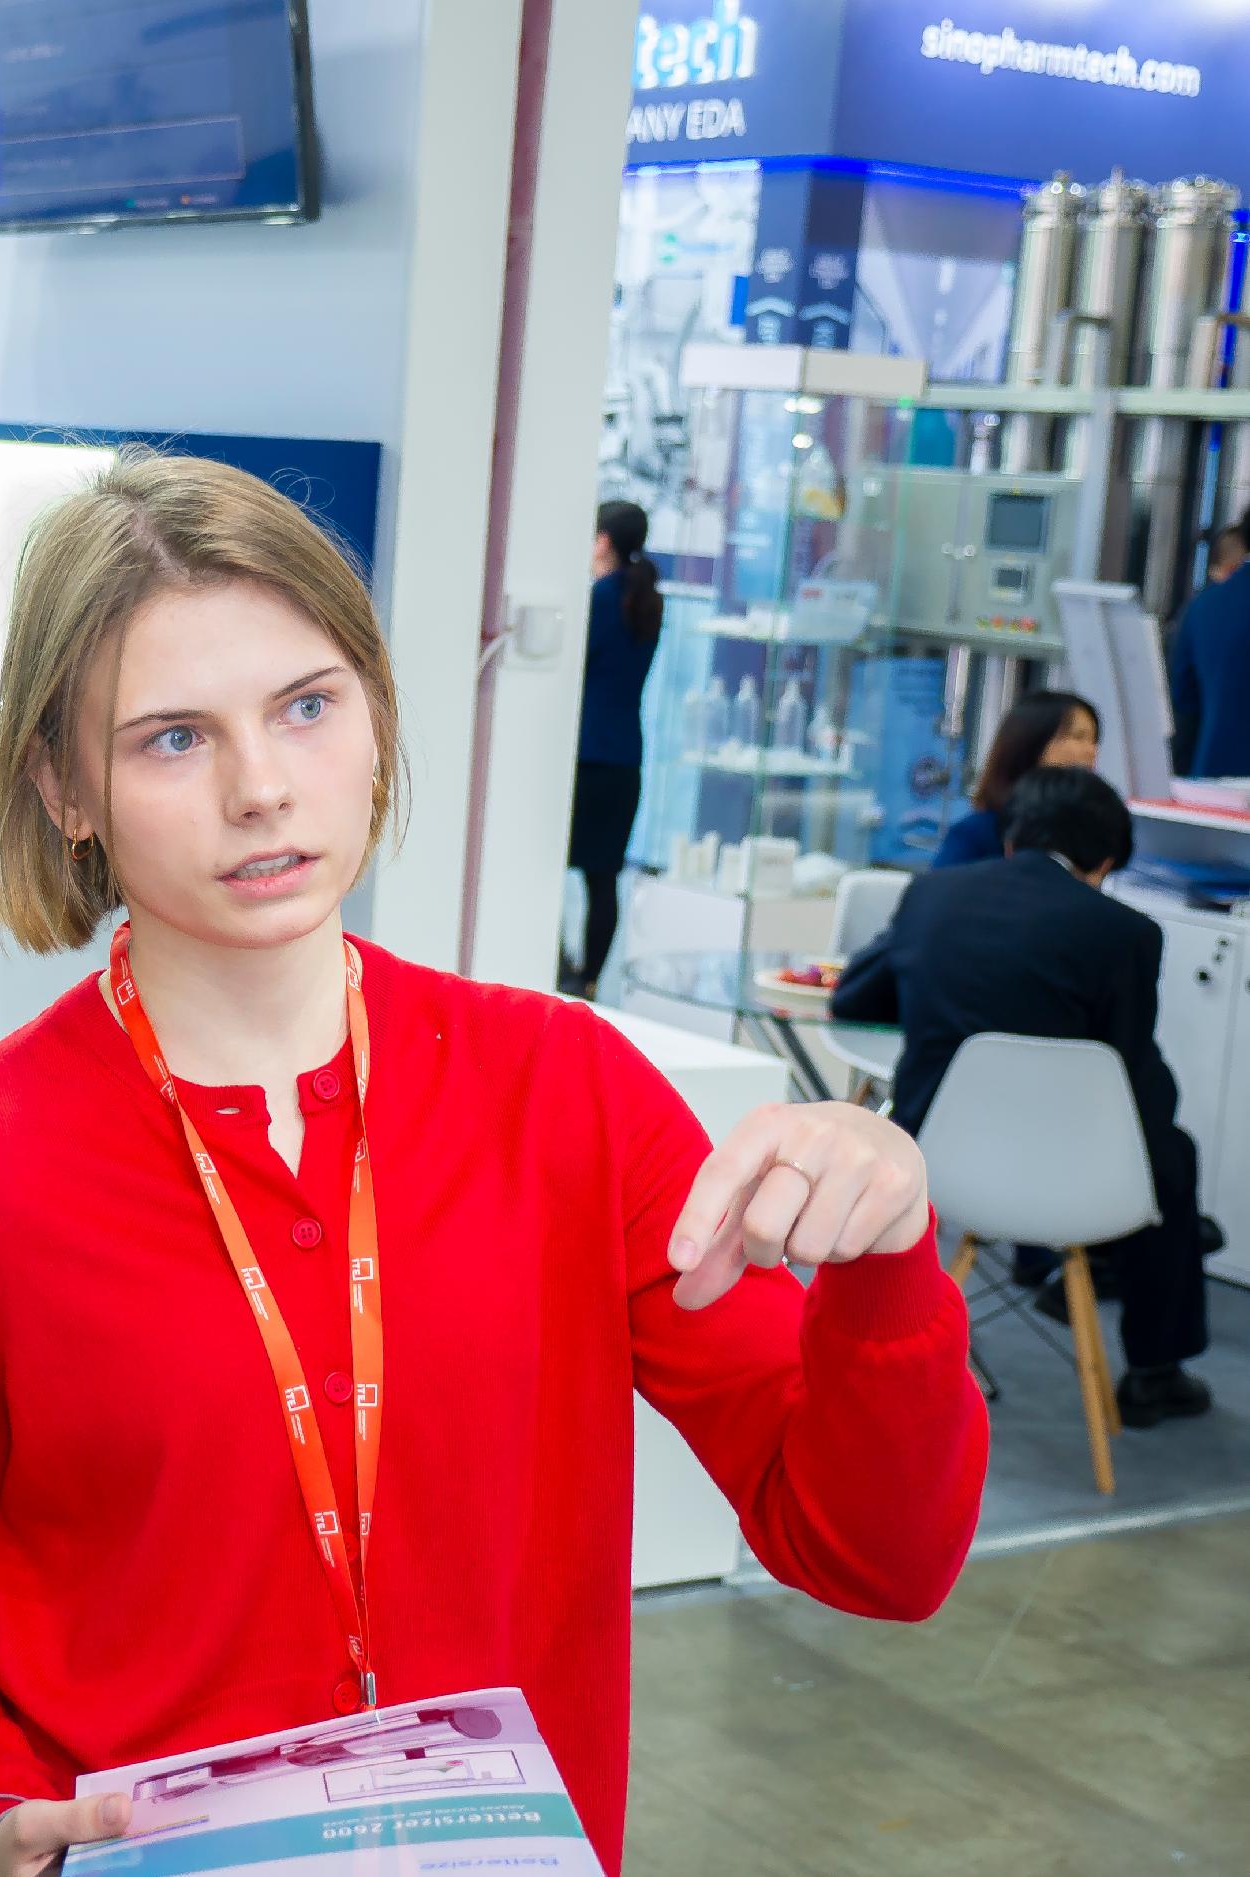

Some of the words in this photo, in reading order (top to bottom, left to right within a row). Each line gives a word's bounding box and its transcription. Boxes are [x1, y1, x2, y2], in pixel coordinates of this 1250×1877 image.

[633, 0, 757, 88] tech
[921, 17, 1200, 97] sinopharmtech.com
[686, 98, 747, 140] EDA
